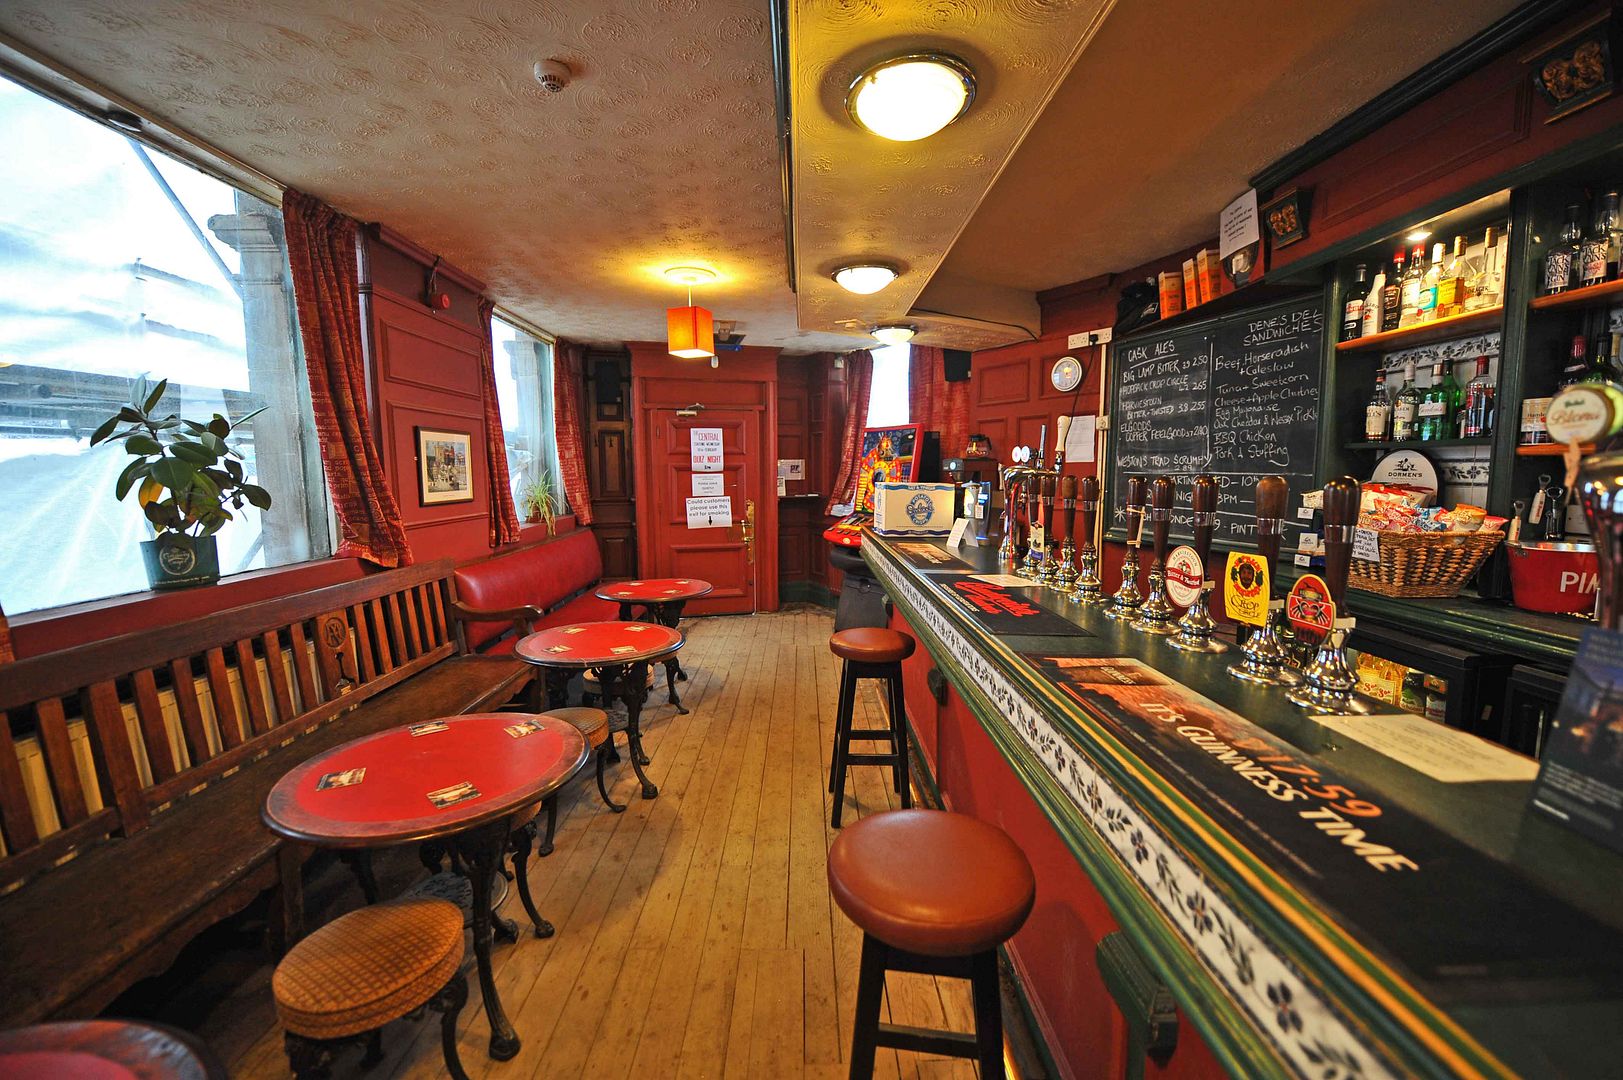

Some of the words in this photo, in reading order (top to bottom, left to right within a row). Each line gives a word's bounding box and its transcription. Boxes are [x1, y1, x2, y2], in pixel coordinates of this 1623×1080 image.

[1243, 317, 1323, 346] SANDWICHES
[1248, 314, 1288, 332] DENE'S
[1128, 346, 1147, 362] CASK
[1155, 340, 1175, 355] ALES
[1123, 370, 1135, 383] BIG
[1138, 364, 1155, 378] LAMP
[1157, 360, 1180, 374] BITTER
[1252, 374, 1309, 389] Sweetcorn
[1216, 407, 1230, 420] Egg
[1213, 431, 1236, 445] BBQ
[1240, 427, 1277, 443] Chicken
[1213, 446, 1234, 460] Pork
[1248, 443, 1289, 467] Stuffing
[1139, 703, 1187, 722] IT'S
[1176, 726, 1309, 801] GUINNESS
[1299, 806, 1420, 873] TIME
